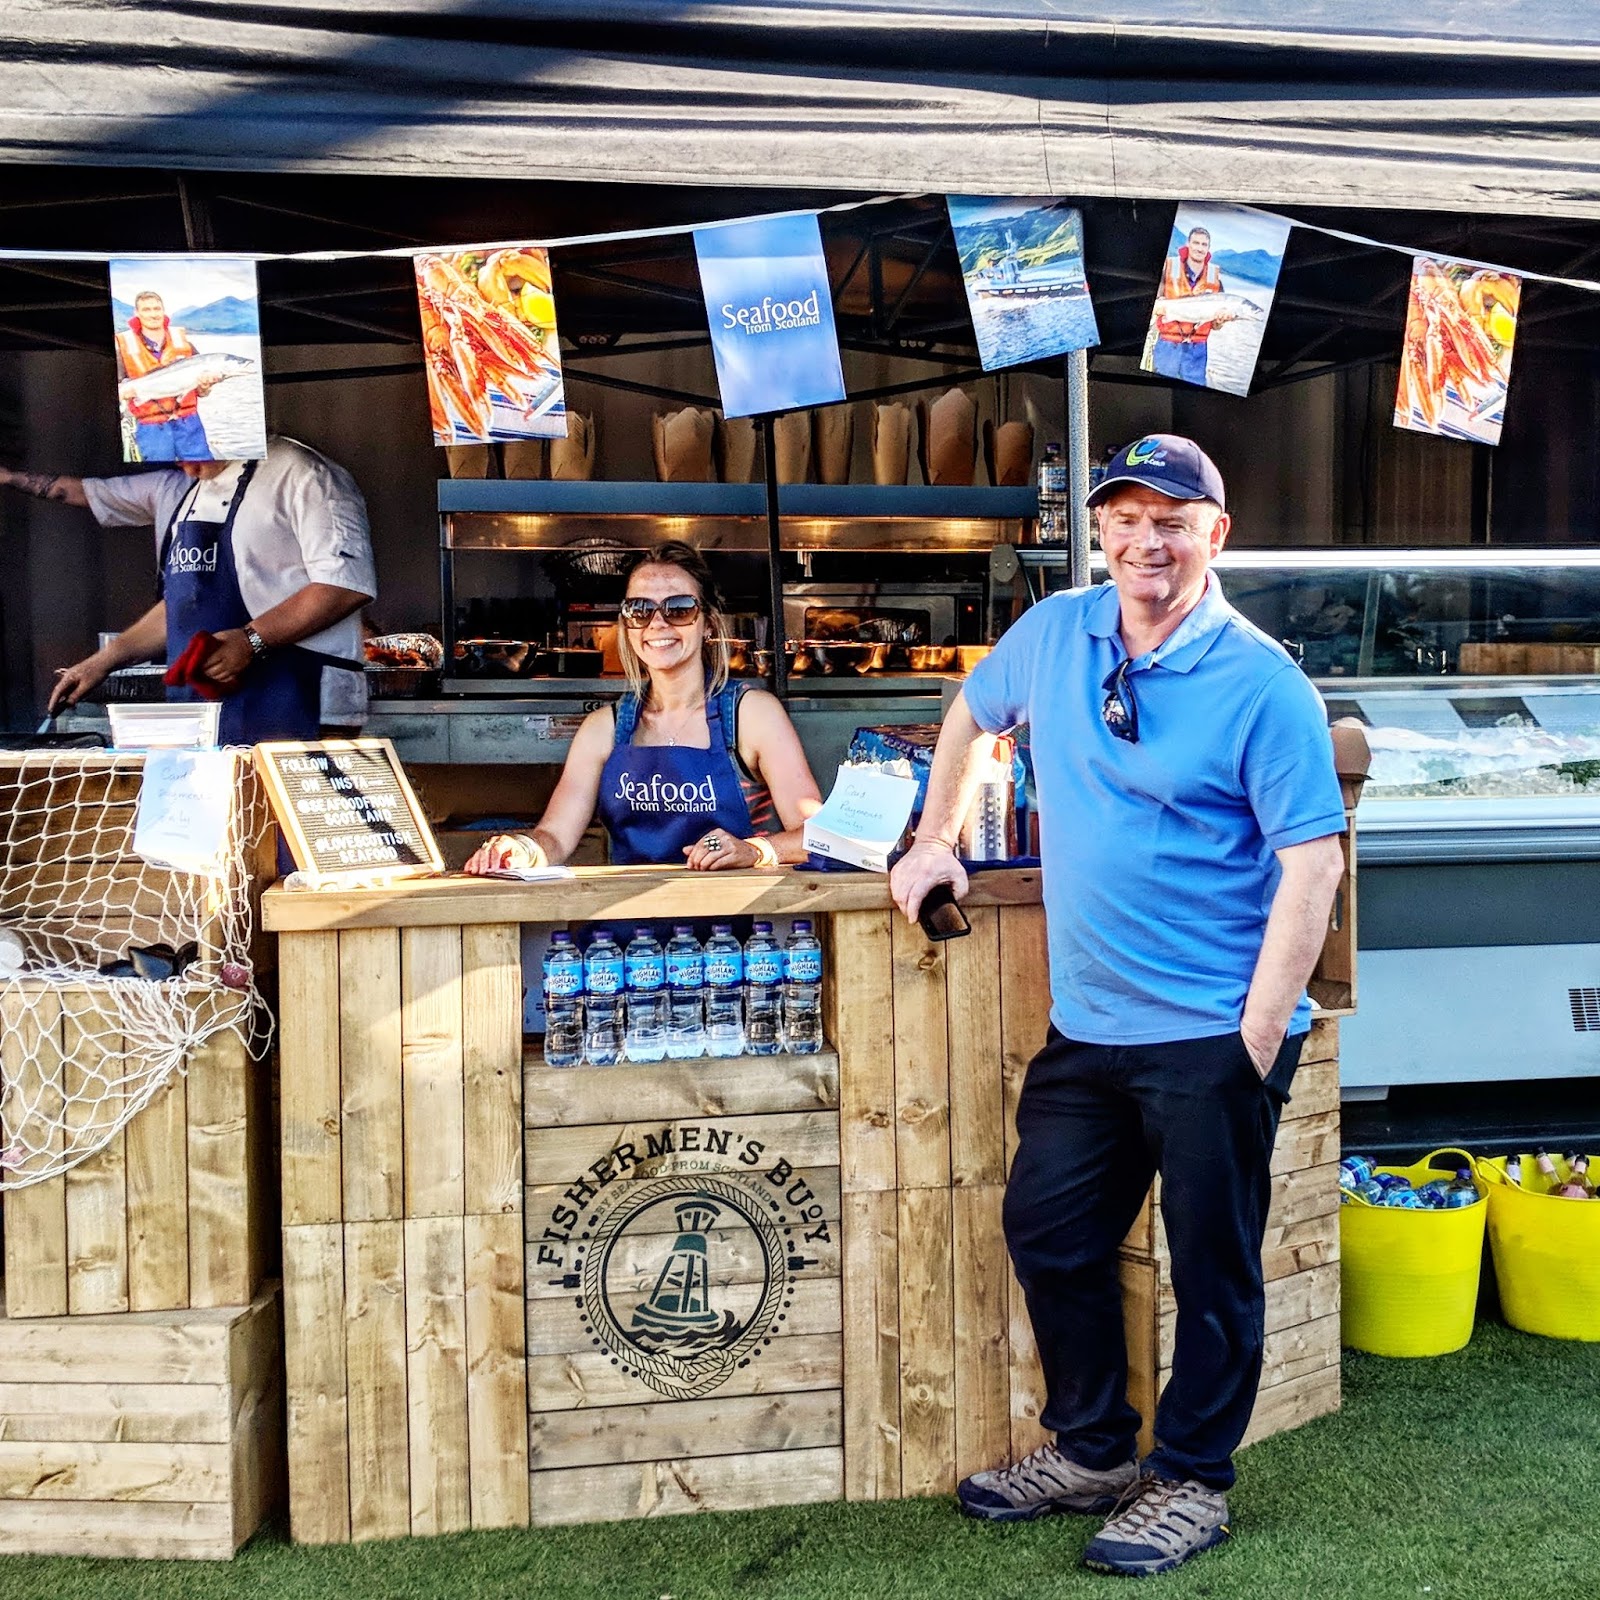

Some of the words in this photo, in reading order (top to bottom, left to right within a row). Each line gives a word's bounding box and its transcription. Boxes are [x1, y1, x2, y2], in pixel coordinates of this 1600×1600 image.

[721, 290, 820, 329] Seafood
[745, 322, 773, 335] from
[775, 314, 821, 331] Scotland
[179, 562, 217, 573] Scotland
[280, 757, 329, 774] FOLLOW
[332, 756, 353, 771] US
[301, 777, 321, 793] ON
[615, 772, 717, 802] Seafood
[630, 800, 660, 812] from
[663, 800, 717, 813] Scotland
[324, 808, 392, 826] SCOTLAND
[339, 846, 399, 864] SEAFOOD
[671, 1160, 710, 1171] FROM
[537, 1127, 765, 1268] FISHERMEN'S
